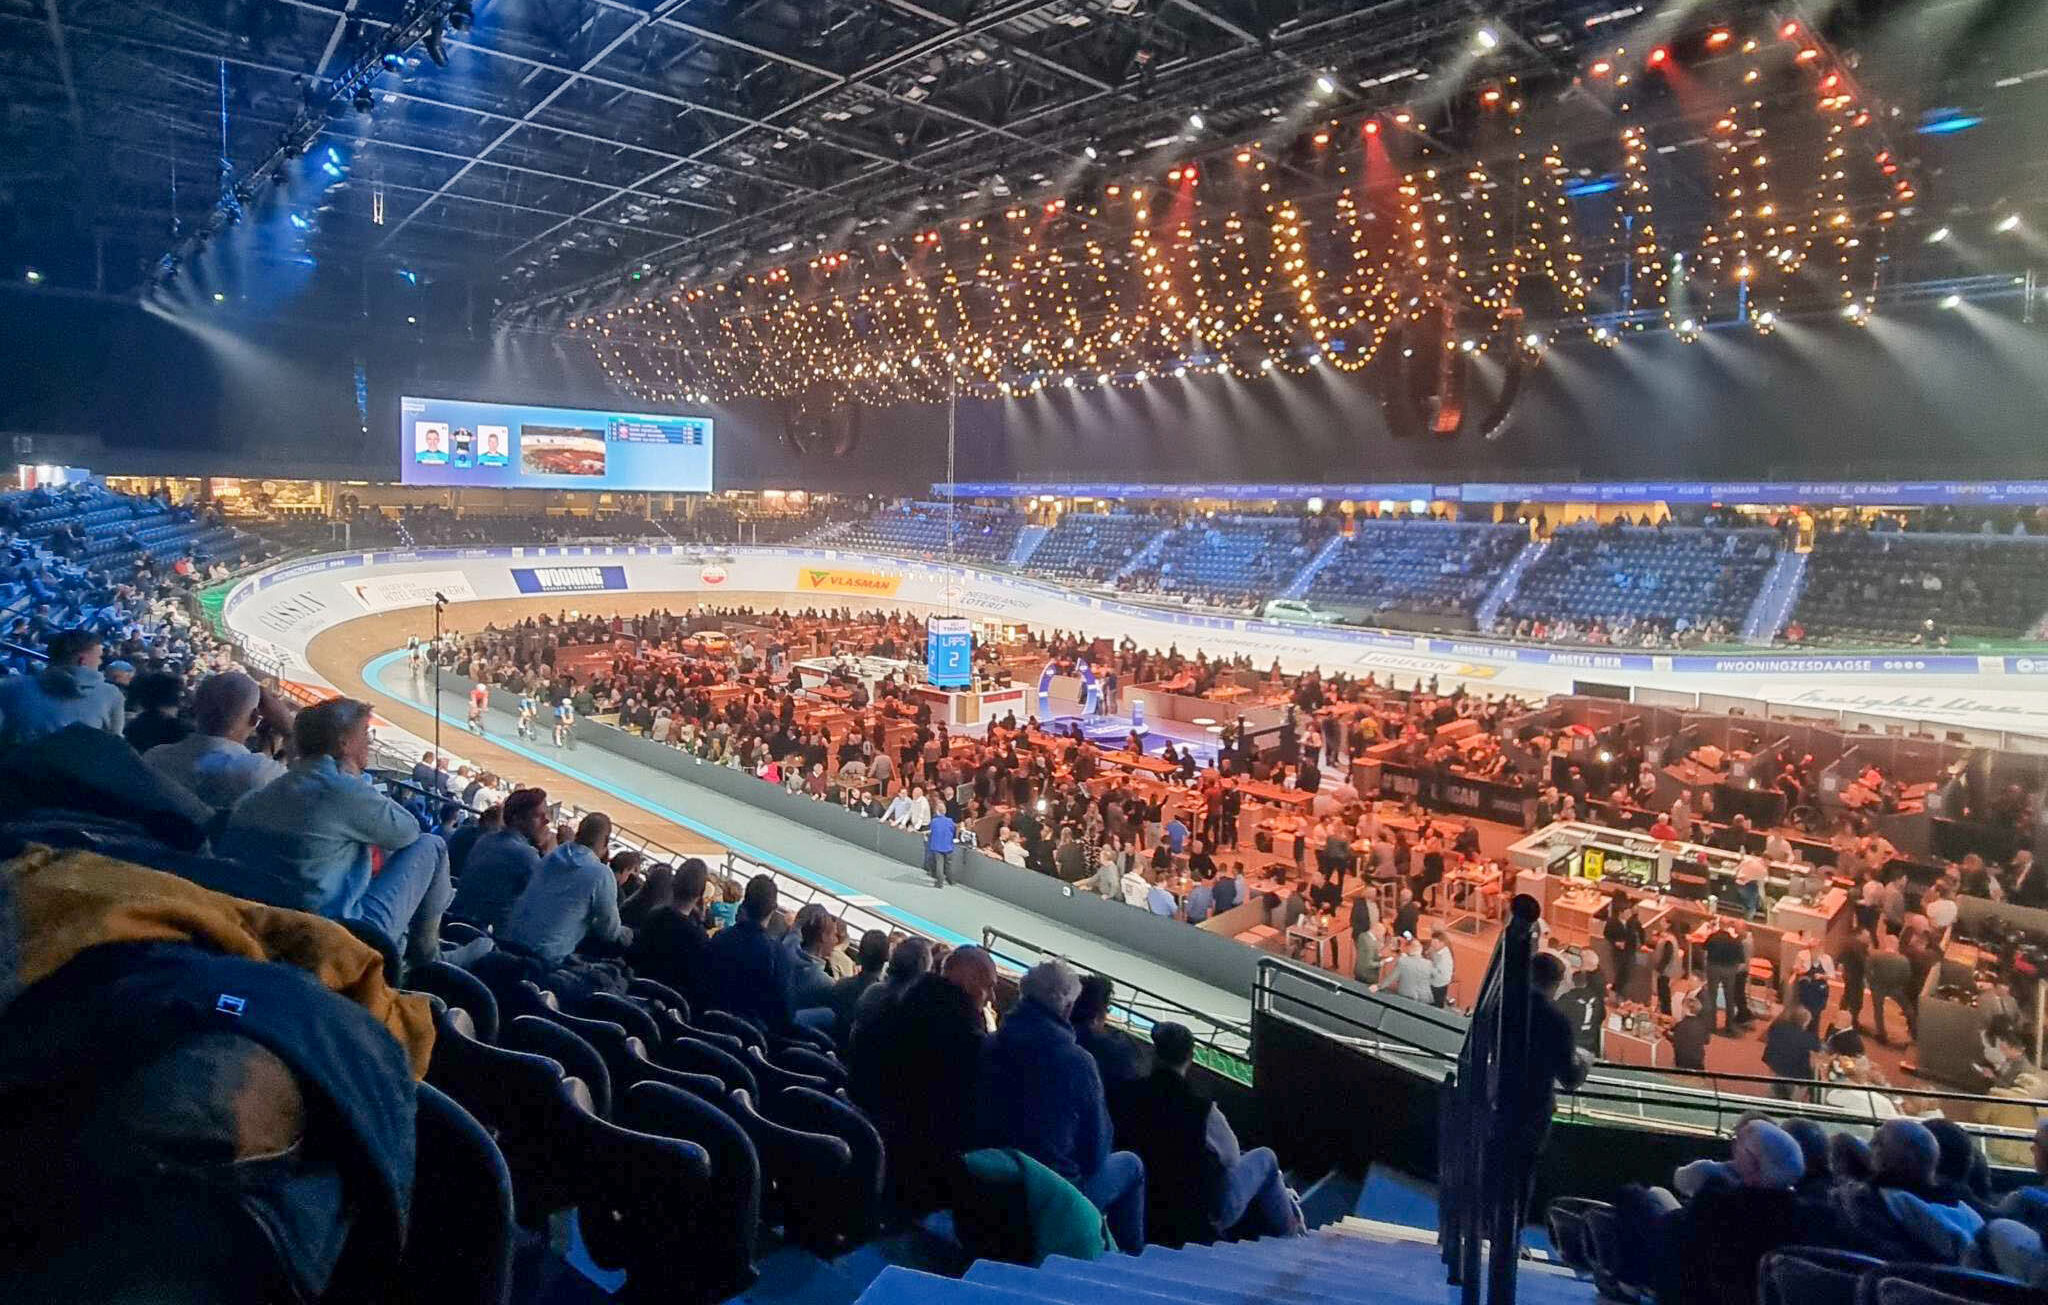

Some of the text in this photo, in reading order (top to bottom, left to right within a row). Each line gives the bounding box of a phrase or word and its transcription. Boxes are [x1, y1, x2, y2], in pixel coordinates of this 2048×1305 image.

[534, 567, 604, 587] WOONING
[831, 576, 890, 590] VLASMAN
[942, 636, 966, 647] LAPS
[948, 651, 960, 667] 2
[1548, 653, 1622, 669] AMSTEL BIER
[1715, 659, 1872, 672] #WOONINGZESDAAGSE
